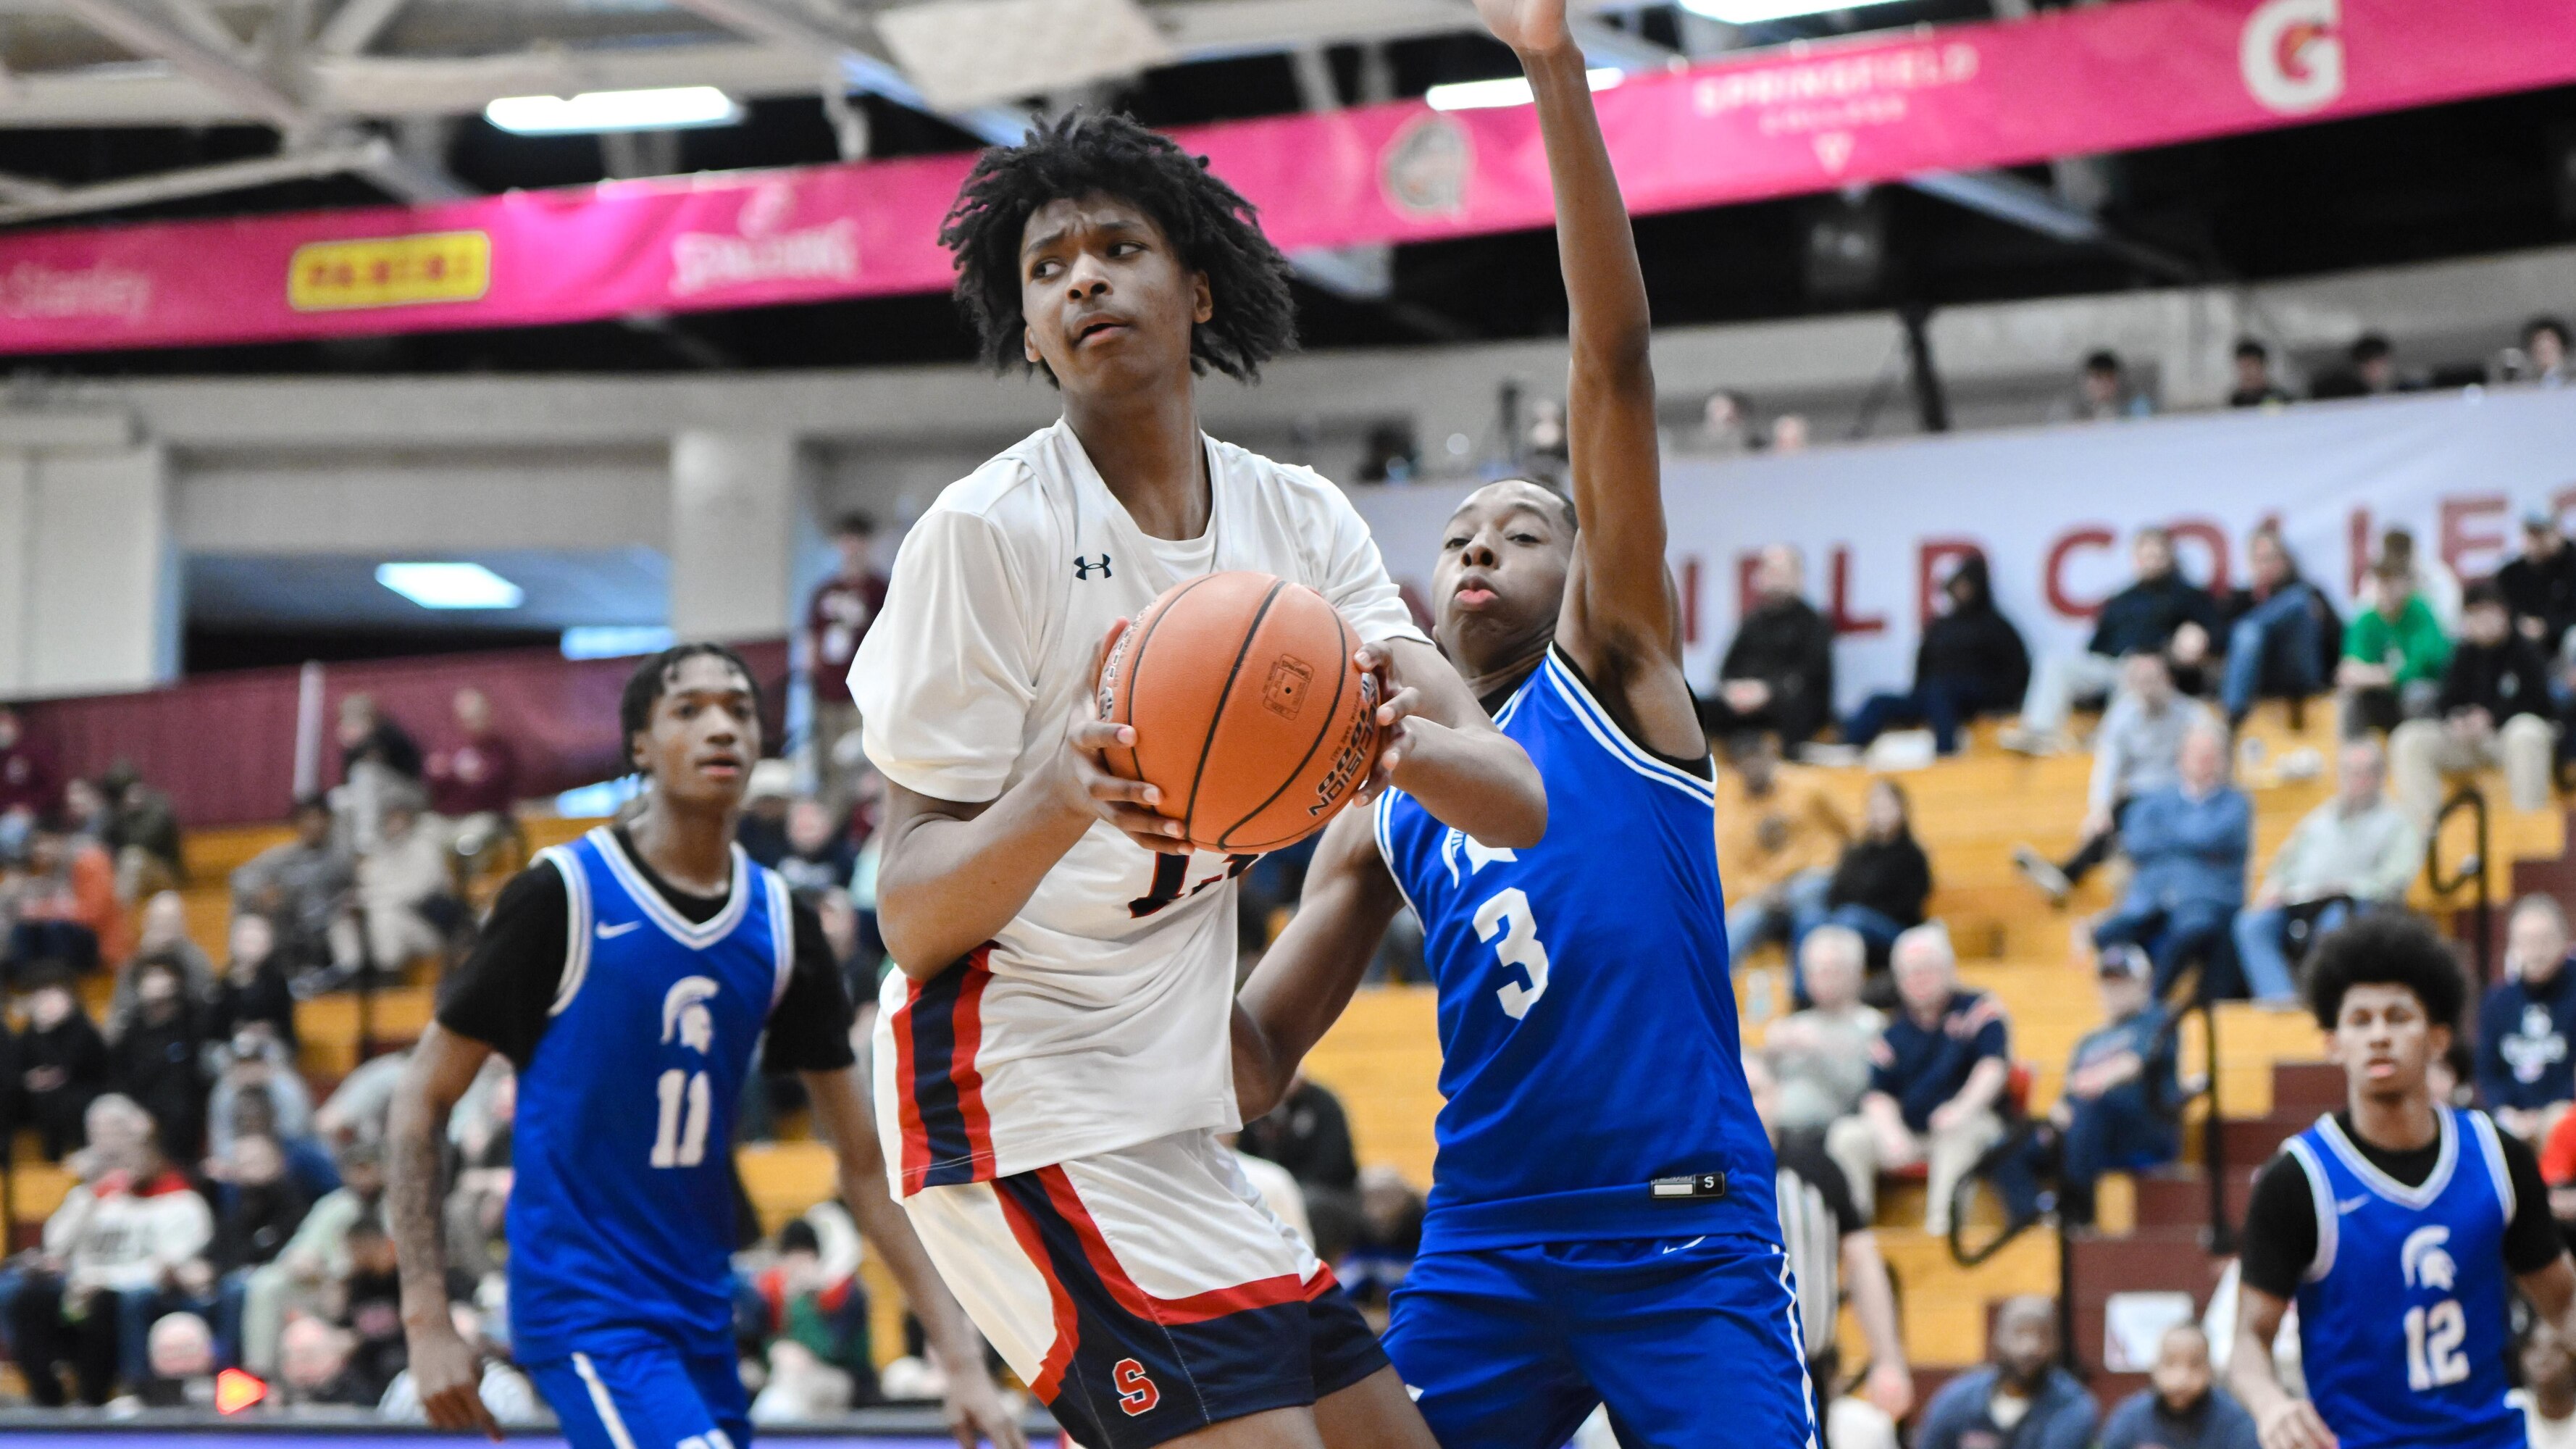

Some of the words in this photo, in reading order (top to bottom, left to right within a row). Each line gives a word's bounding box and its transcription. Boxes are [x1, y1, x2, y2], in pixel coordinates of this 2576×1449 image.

[2238, 0, 2346, 114] G
[1472, 886, 1549, 1021] 3
[650, 1068, 711, 1169] 11
[1704, 1176, 1715, 1188] S
[1112, 1357, 1161, 1417] S
[2403, 1298, 2471, 1392] 12
